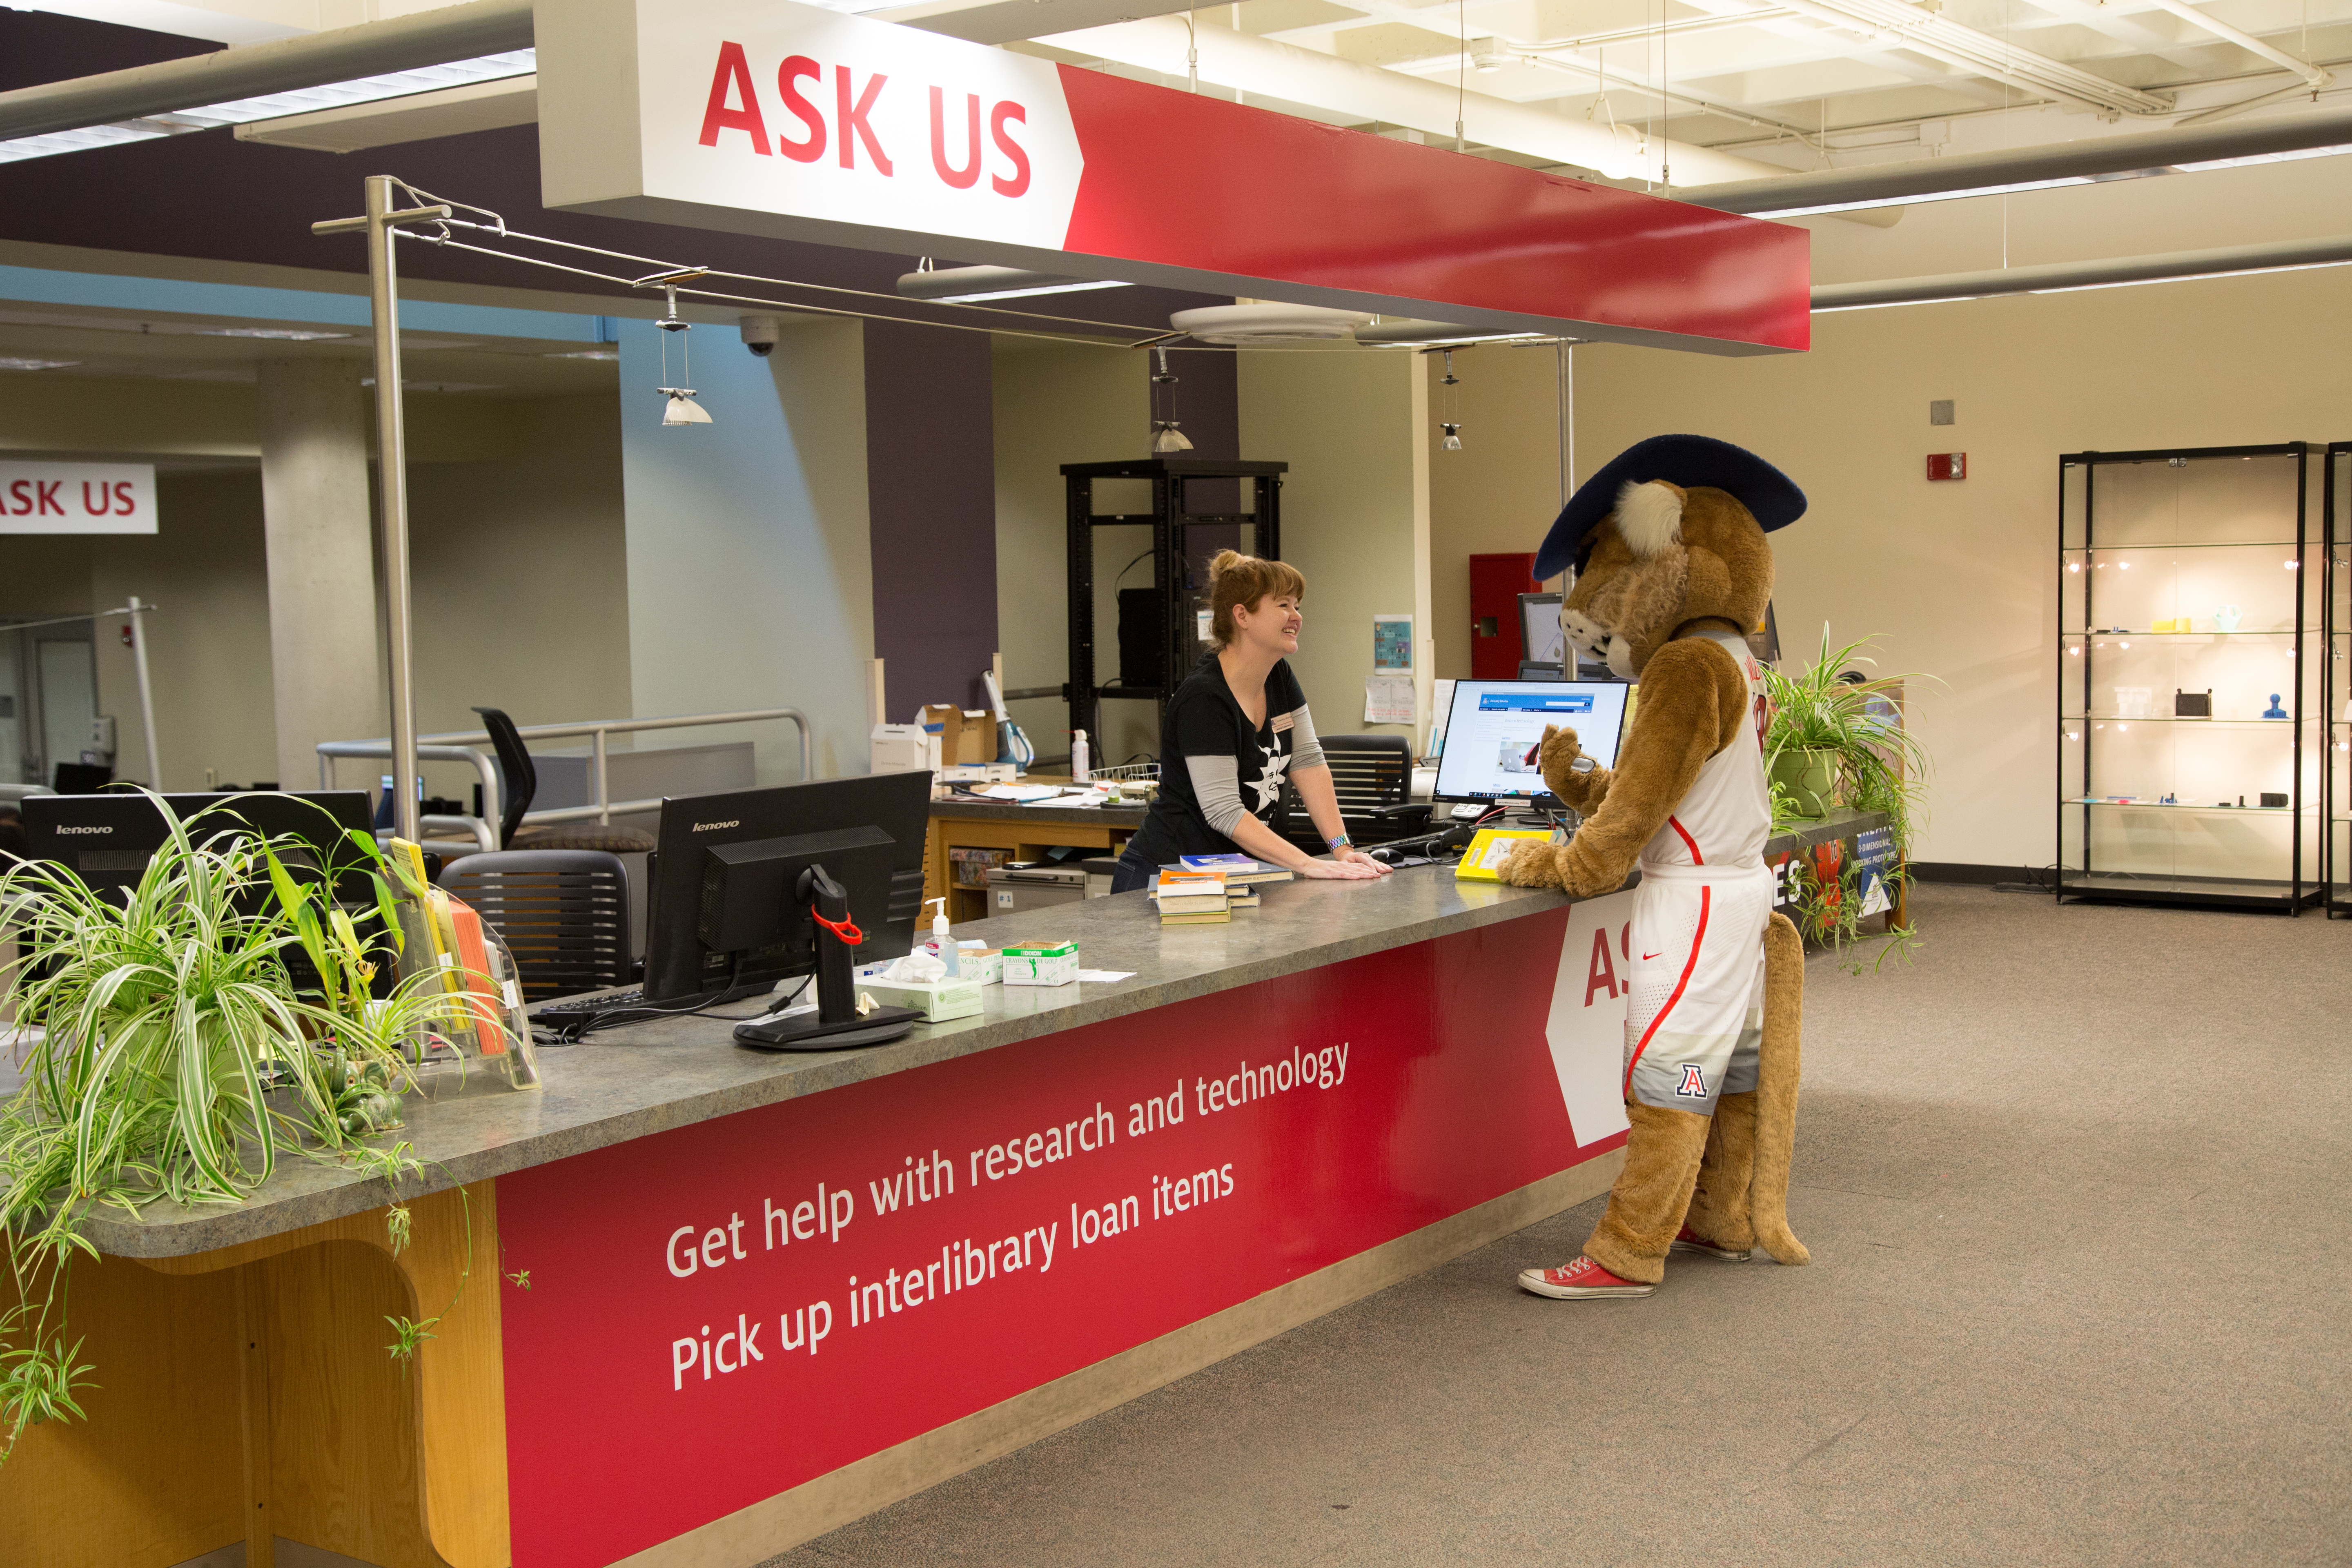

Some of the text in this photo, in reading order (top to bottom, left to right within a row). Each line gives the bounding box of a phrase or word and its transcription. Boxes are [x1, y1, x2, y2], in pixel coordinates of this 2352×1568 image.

[699, 40, 1031, 198] ASK US
[82, 481, 135, 517] US
[56, 824, 113, 835] lenovo
[692, 820, 739, 832] lenovo
[1463, 840, 1479, 863] Children's
[1676, 1064, 1708, 1098] A
[666, 1042, 1349, 1278] Get help with research and technology
[673, 1163, 1234, 1392] Pick up interlibrary loan items
